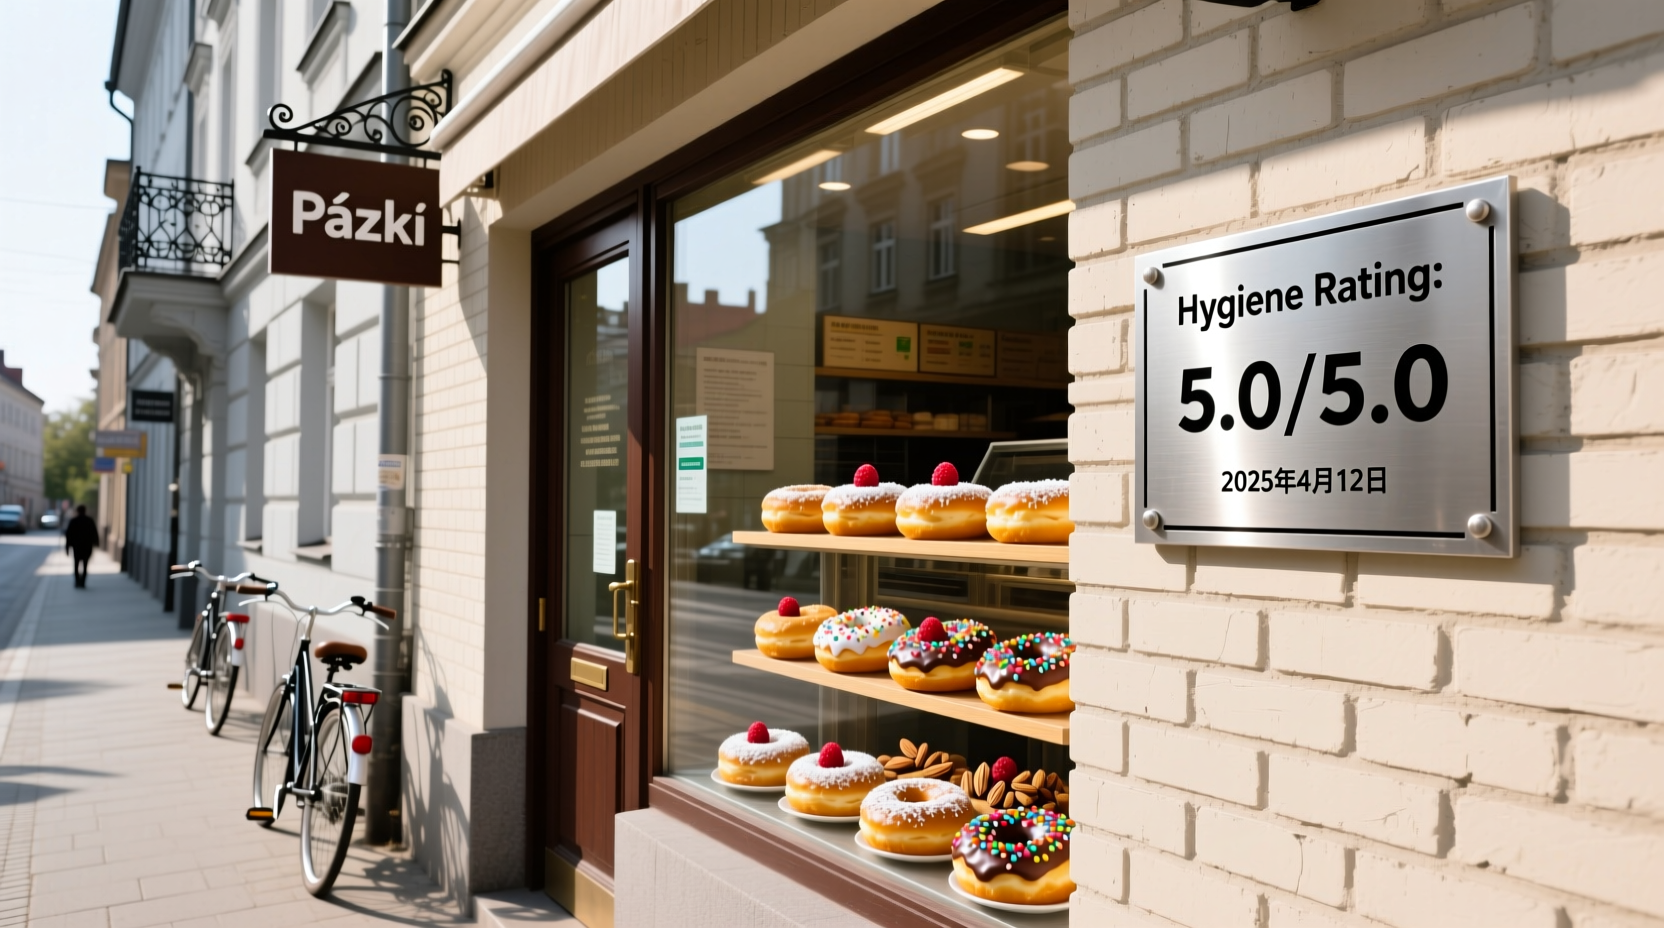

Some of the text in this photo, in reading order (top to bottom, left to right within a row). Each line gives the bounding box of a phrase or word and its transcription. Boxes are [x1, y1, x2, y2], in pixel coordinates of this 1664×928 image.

[1178, 261, 1443, 331] Hygiene Rating:
[1178, 343, 1448, 437] 5.0/5.0
[1221, 466, 1387, 495] 2025年4月12日
